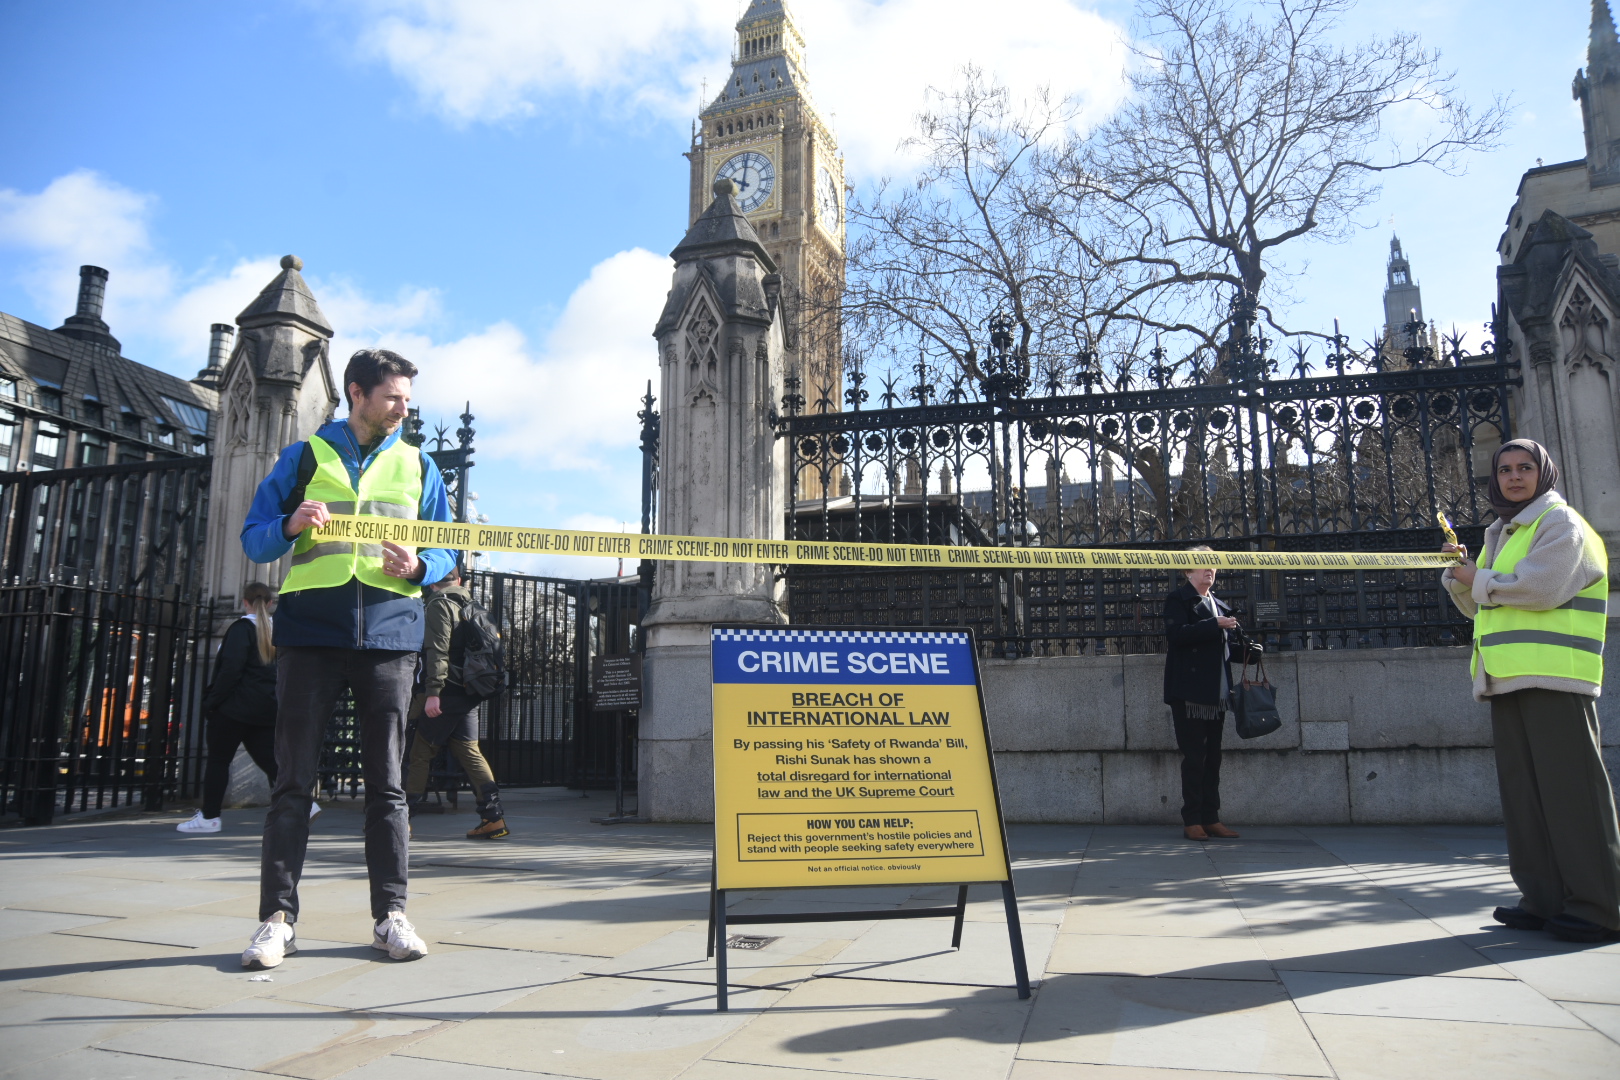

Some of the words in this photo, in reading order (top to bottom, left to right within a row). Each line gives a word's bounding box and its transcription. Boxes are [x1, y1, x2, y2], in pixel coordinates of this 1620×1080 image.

[412, 525, 435, 543] NOT
[437, 527, 470, 546] ENTER
[478, 530, 513, 548] CRIME
[573, 535, 595, 552] NOT
[598, 537, 630, 553] ENTER
[639, 538, 673, 555] CRIME
[732, 542, 755, 558] NOT
[757, 543, 788, 559] ENTER
[796, 544, 830, 560] CRIME
[886, 548, 908, 562] NOT
[911, 549, 941, 562] ENTER
[948, 549, 980, 563] CRIME
[1034, 551, 1054, 564] NOT
[1056, 552, 1085, 564] ENTER
[1091, 552, 1123, 564] CRIME
[1173, 554, 1192, 565] NOT
[1193, 554, 1222, 565] ENTER
[1227, 554, 1256, 565] CRIME
[1303, 555, 1321, 565] NOT
[1323, 555, 1349, 565] ENTER
[1353, 555, 1381, 565] CRIME
[1422, 556, 1441, 565] NOT
[737, 650, 840, 673] CRIME
[847, 652, 950, 674] SCENE
[792, 693, 872, 706] BREACH
[879, 693, 904, 706] OF
[747, 711, 904, 725] INTERNATIONAL
[909, 712, 950, 725] LAW
[734, 739, 750, 750] By
[754, 739, 803, 750] passing
[806, 739, 825, 749] his
[874, 739, 886, 749] of
[946, 738, 968, 749] Bill,
[776, 755, 806, 765] Rishi
[811, 755, 850, 764] Sunak
[854, 755, 876, 764] has
[880, 755, 920, 764] shown
[757, 771, 786, 781] total
[789, 771, 849, 783] disregard
[853, 771, 870, 780] for
[874, 770, 951, 780] international
[758, 788, 780, 798] law
[784, 788, 808, 798] and
[812, 787, 832, 797] the
[836, 787, 855, 797] UK
[859, 787, 915, 798] Supreme
[919, 786, 954, 796] Court
[807, 819, 831, 829] HOW
[834, 819, 855, 829] YOU
[859, 819, 880, 829] CAN
[883, 818, 913, 828] HELP:
[747, 834, 781, 844] Reject
[784, 833, 802, 842] this
[877, 832, 910, 841] hostile
[913, 831, 951, 841] policies
[954, 830, 972, 839] and
[747, 844, 777, 853] stand
[780, 844, 801, 853] with
[804, 844, 839, 854] people
[842, 843, 881, 853] seeking
[884, 842, 915, 852] safety
[918, 841, 974, 850] everywhere
